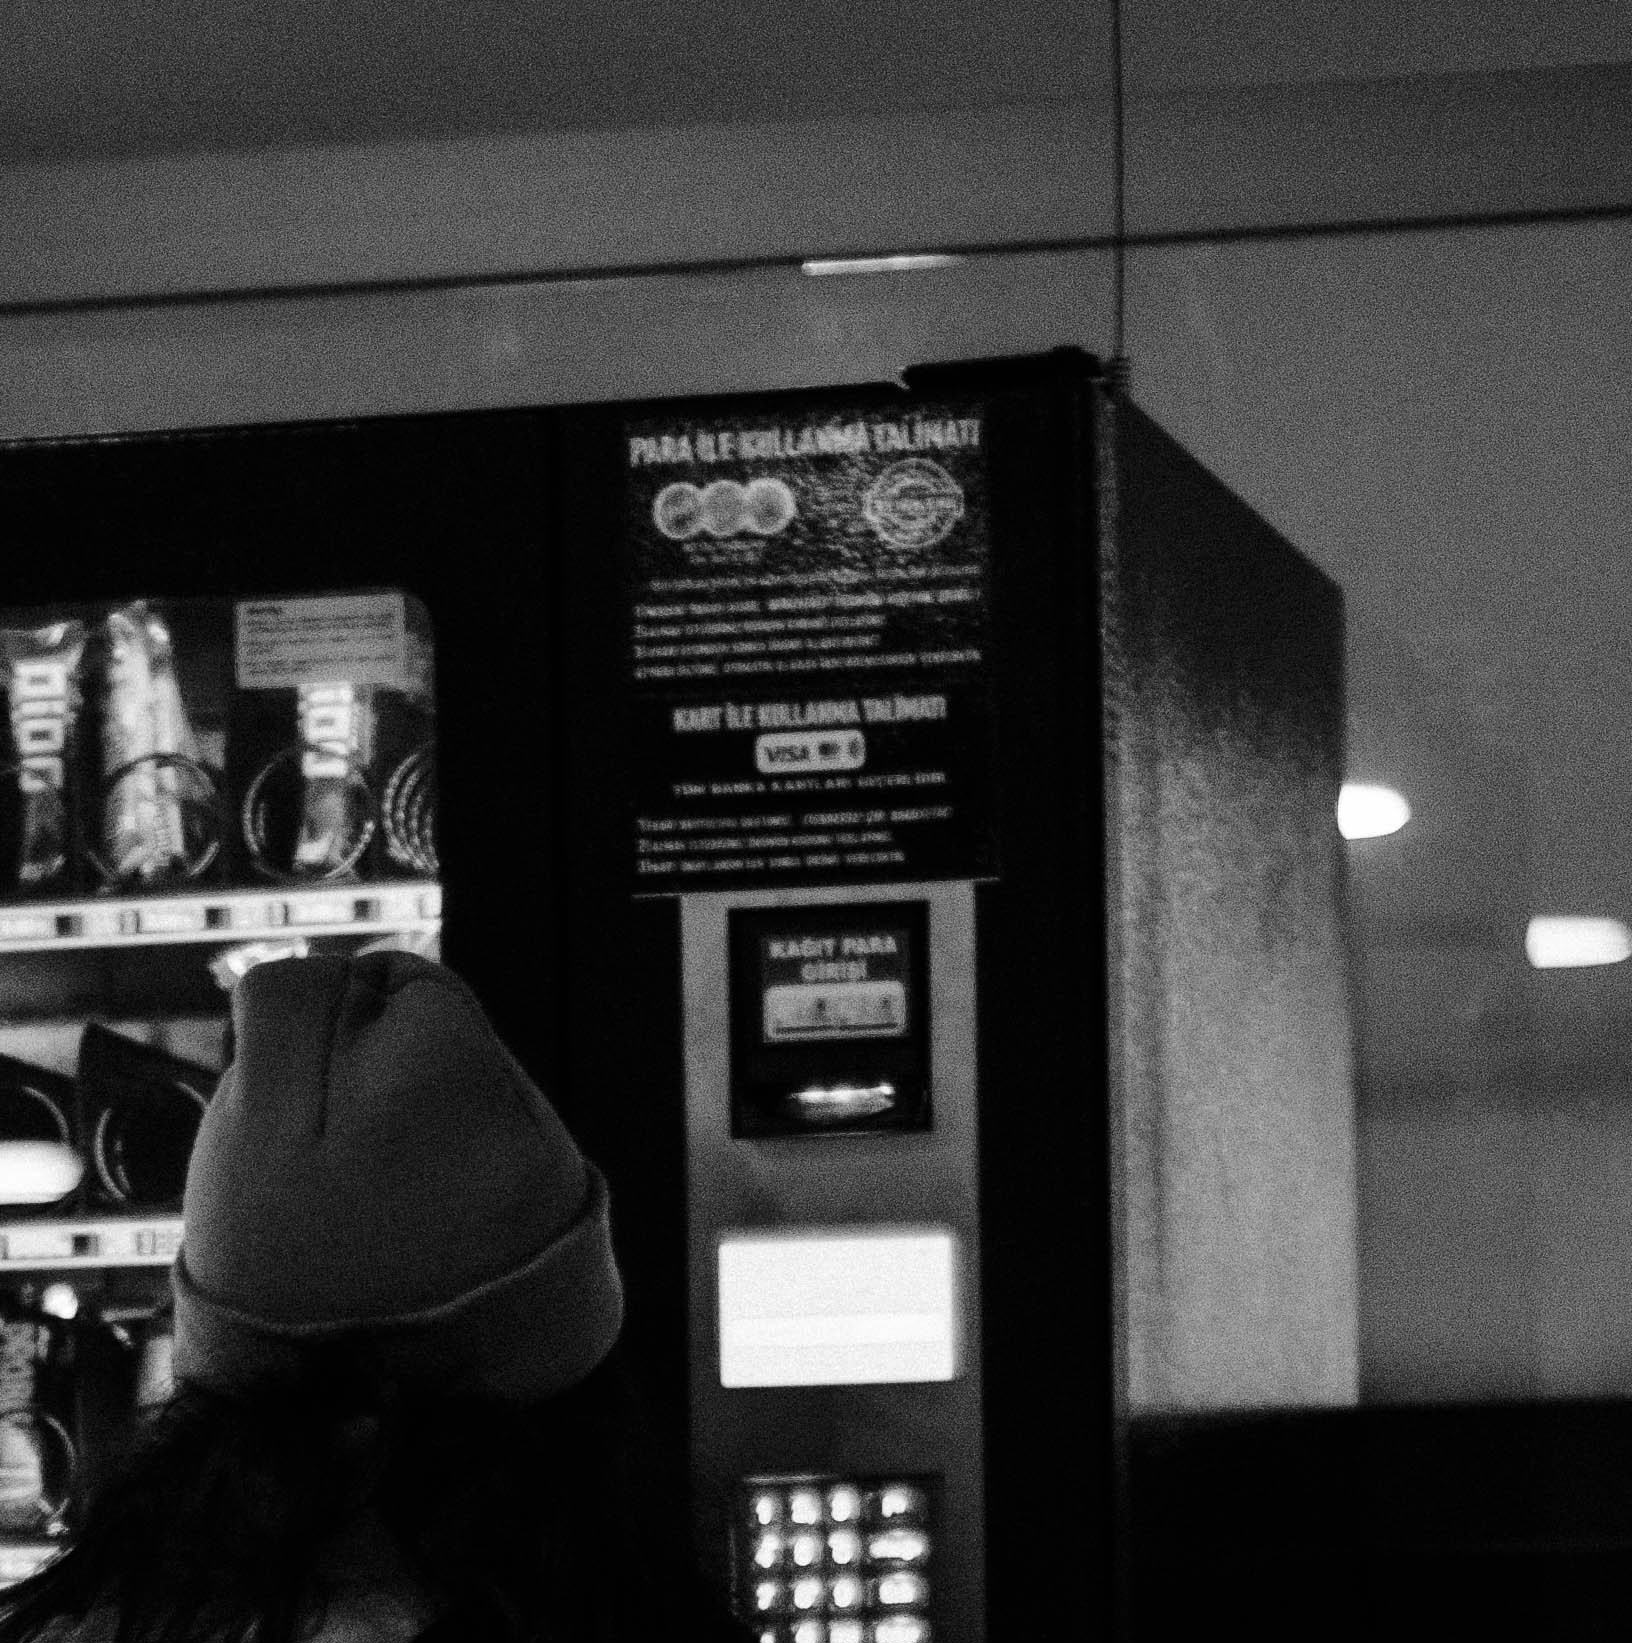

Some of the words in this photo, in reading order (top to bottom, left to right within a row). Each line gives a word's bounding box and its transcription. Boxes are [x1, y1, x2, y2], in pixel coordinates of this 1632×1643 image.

[629, 436, 693, 467] PARA
[765, 743, 809, 764] VISA
[842, 935, 898, 956] PARA
